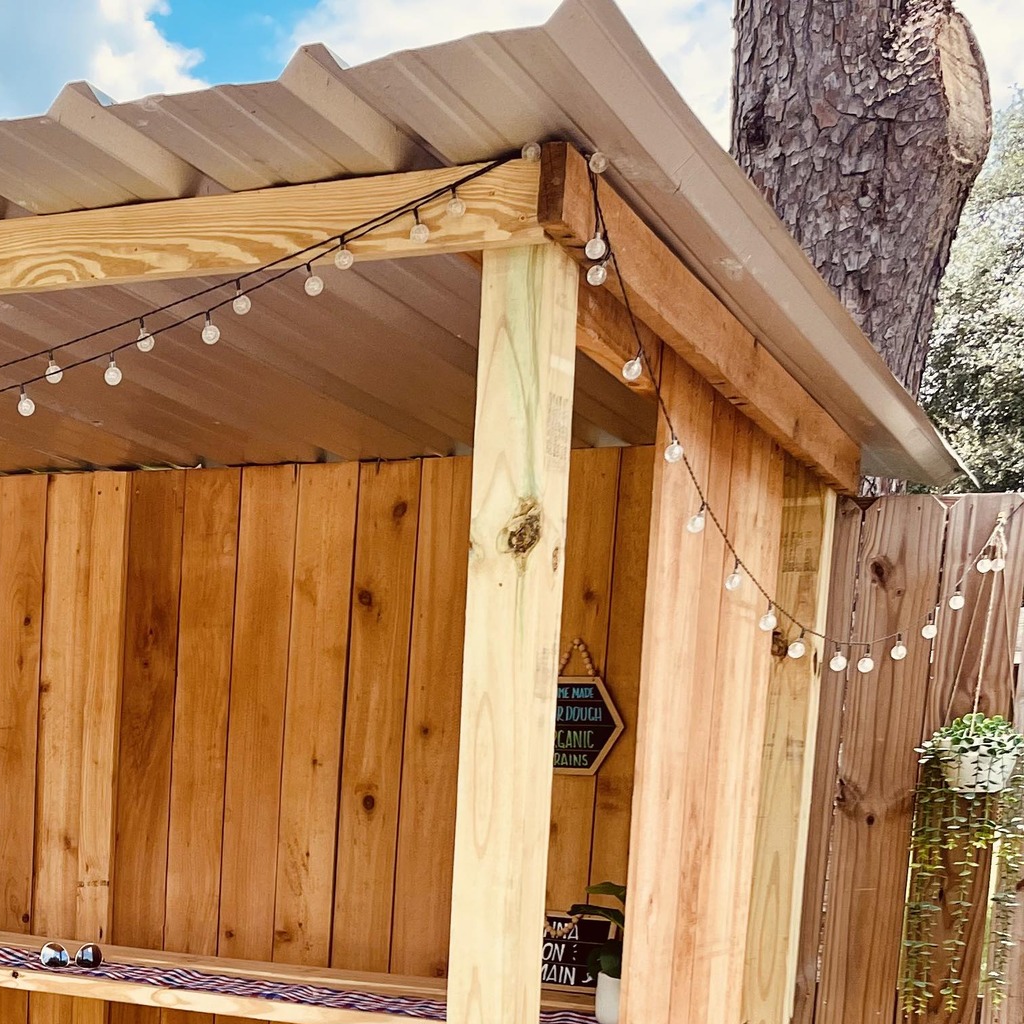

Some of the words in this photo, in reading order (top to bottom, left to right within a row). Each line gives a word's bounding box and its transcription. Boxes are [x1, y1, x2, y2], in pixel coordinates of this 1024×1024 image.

[558, 687, 570, 698] ME
[571, 687, 594, 698] MADE
[556, 705, 602, 722] RDOUGH
[554, 729, 594, 749] GANIC
[553, 752, 589, 767] RAINS
[541, 942, 566, 962] ON
